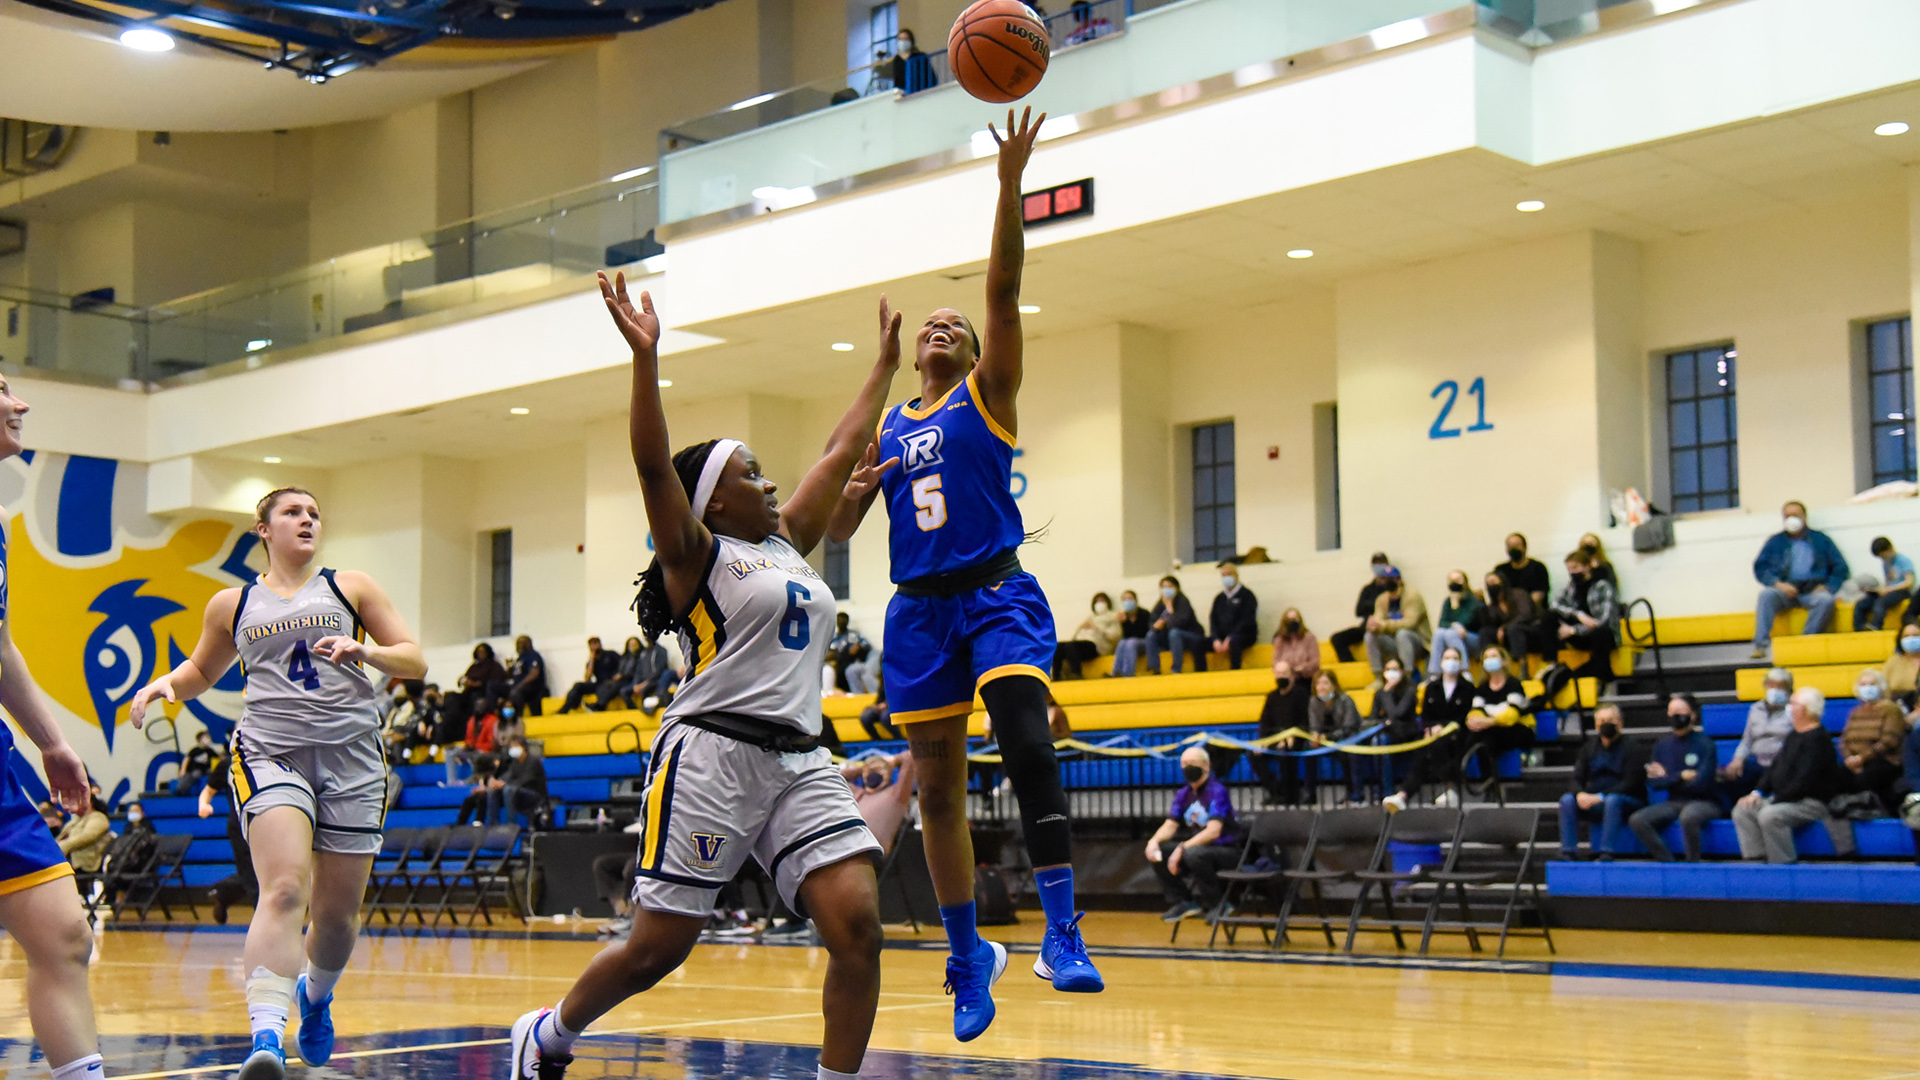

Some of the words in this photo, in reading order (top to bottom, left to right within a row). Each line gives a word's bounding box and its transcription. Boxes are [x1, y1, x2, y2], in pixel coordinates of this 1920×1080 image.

[947, 401, 968, 411] OUA
[1429, 376, 1494, 439] 21
[898, 425, 944, 475] R
[911, 473, 947, 532] 5
[243, 613, 341, 644] VOYAGEURS
[778, 580, 811, 651] 6
[287, 639, 320, 691] 4
[691, 832, 727, 862] V
